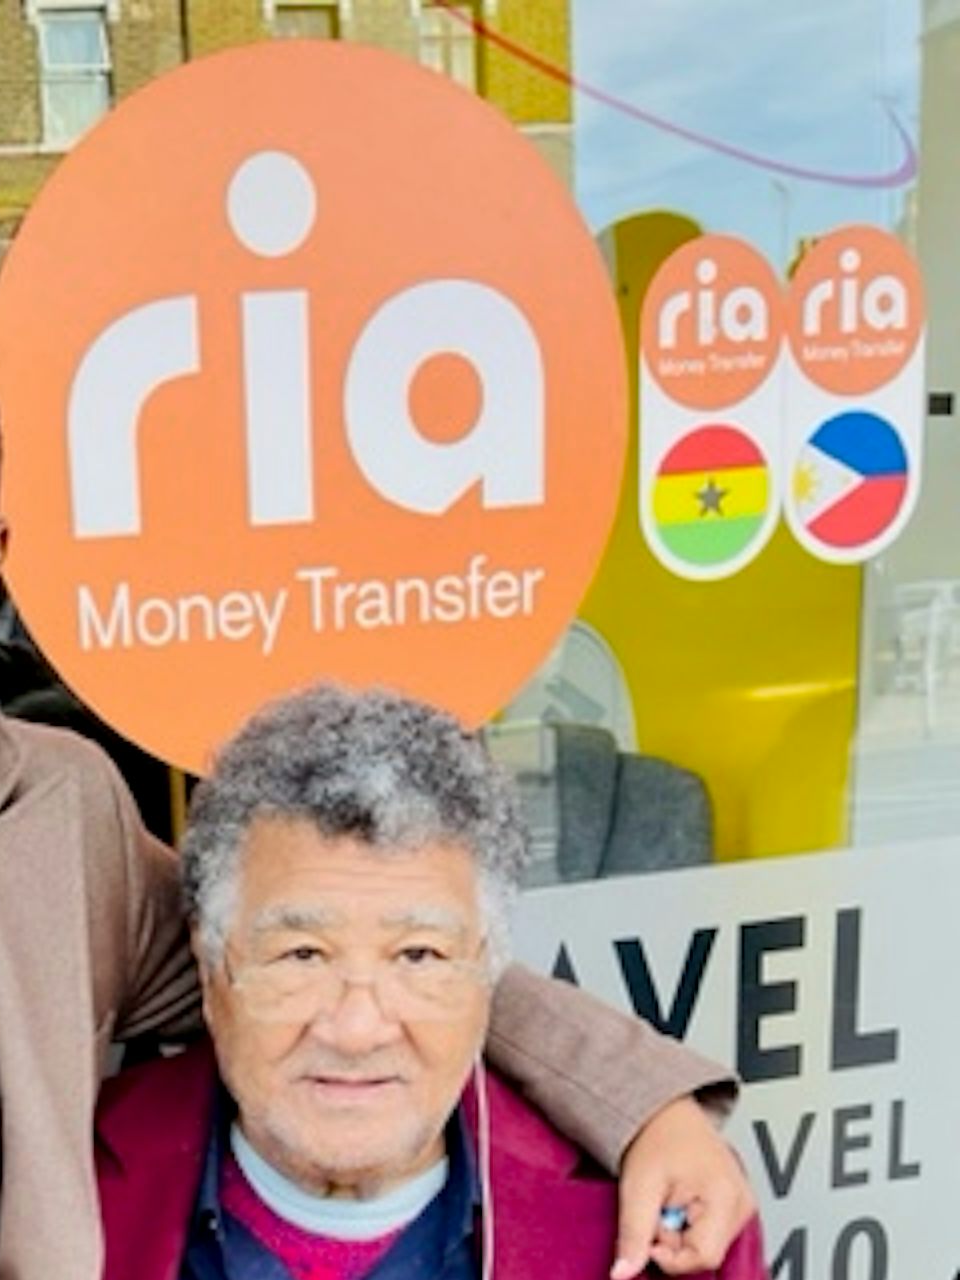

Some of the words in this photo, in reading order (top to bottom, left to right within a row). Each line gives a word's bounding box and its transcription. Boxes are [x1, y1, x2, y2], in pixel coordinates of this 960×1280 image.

[658, 258, 769, 349] ria
[802, 247, 907, 336] ria
[67, 150, 545, 538] ria
[76, 582, 287, 656] Money
[296, 554, 544, 632] Transfer
[752, 1099, 921, 1199] VEL
